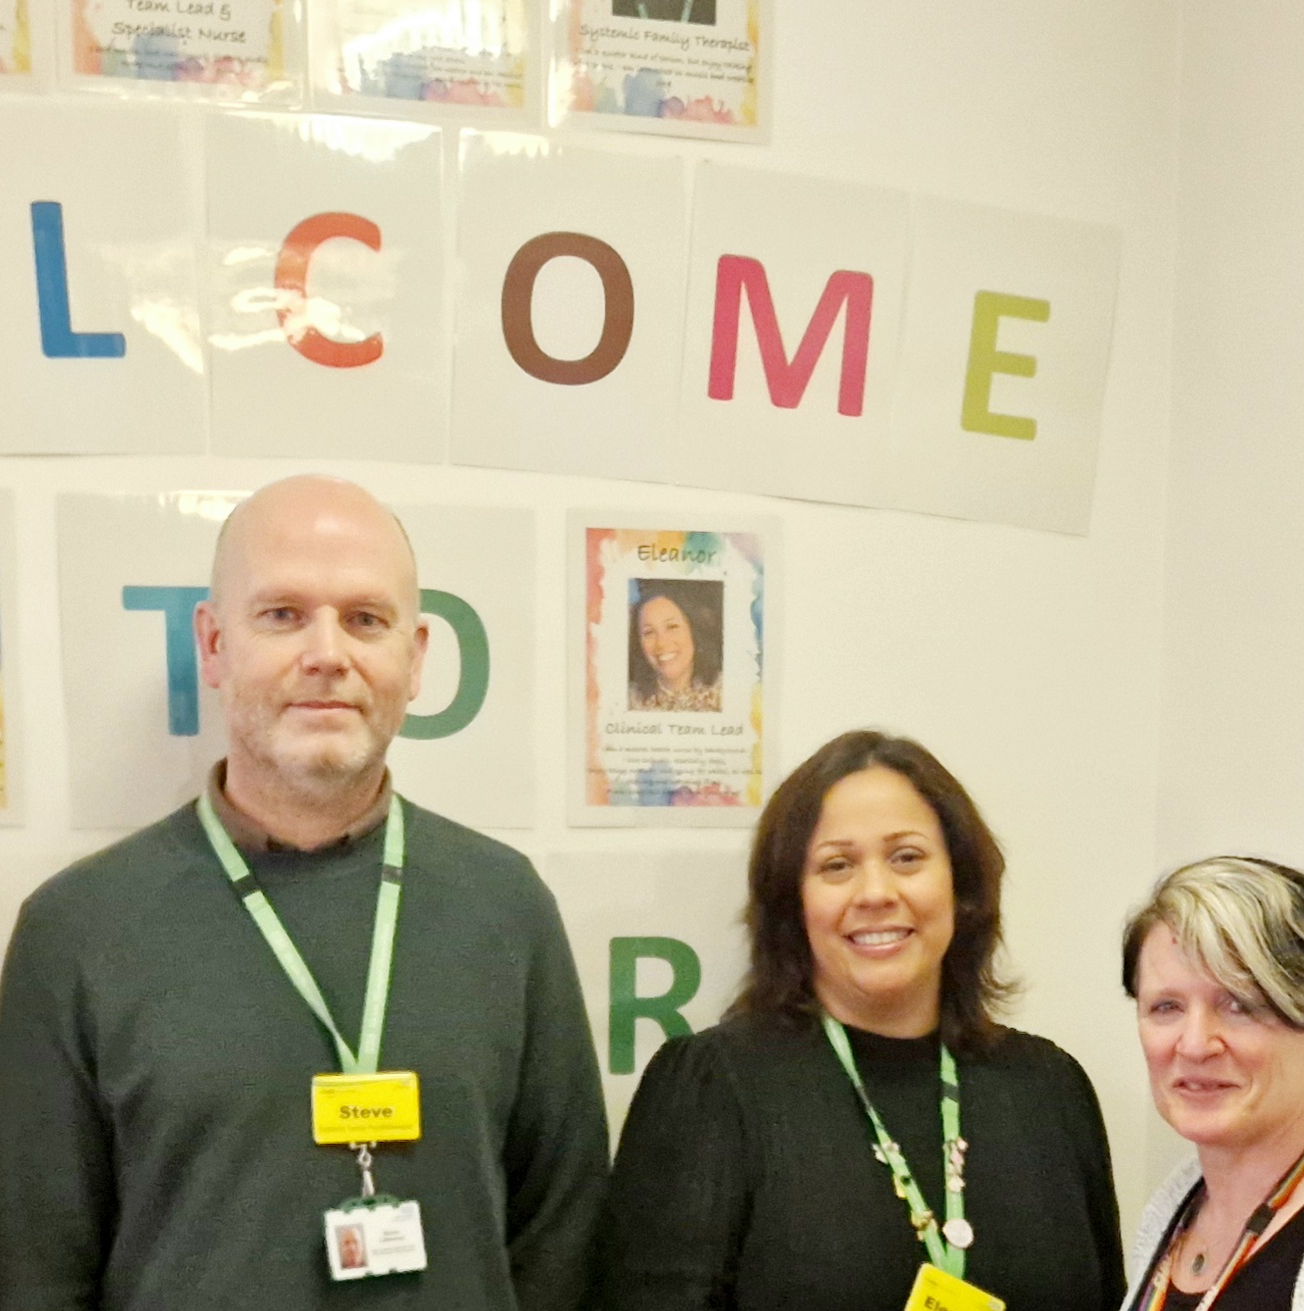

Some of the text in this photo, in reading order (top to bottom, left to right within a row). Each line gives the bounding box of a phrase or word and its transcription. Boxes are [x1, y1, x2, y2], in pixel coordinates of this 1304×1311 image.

[176, 0, 214, 15] Lead
[111, 22, 247, 43] Specialist Nurse
[578, 24, 751, 53] Systemic Family Therapist
[637, 545, 717, 565] Eleanor
[605, 722, 744, 736] Clinical Team Lead
[339, 1105, 393, 1120] Steve
